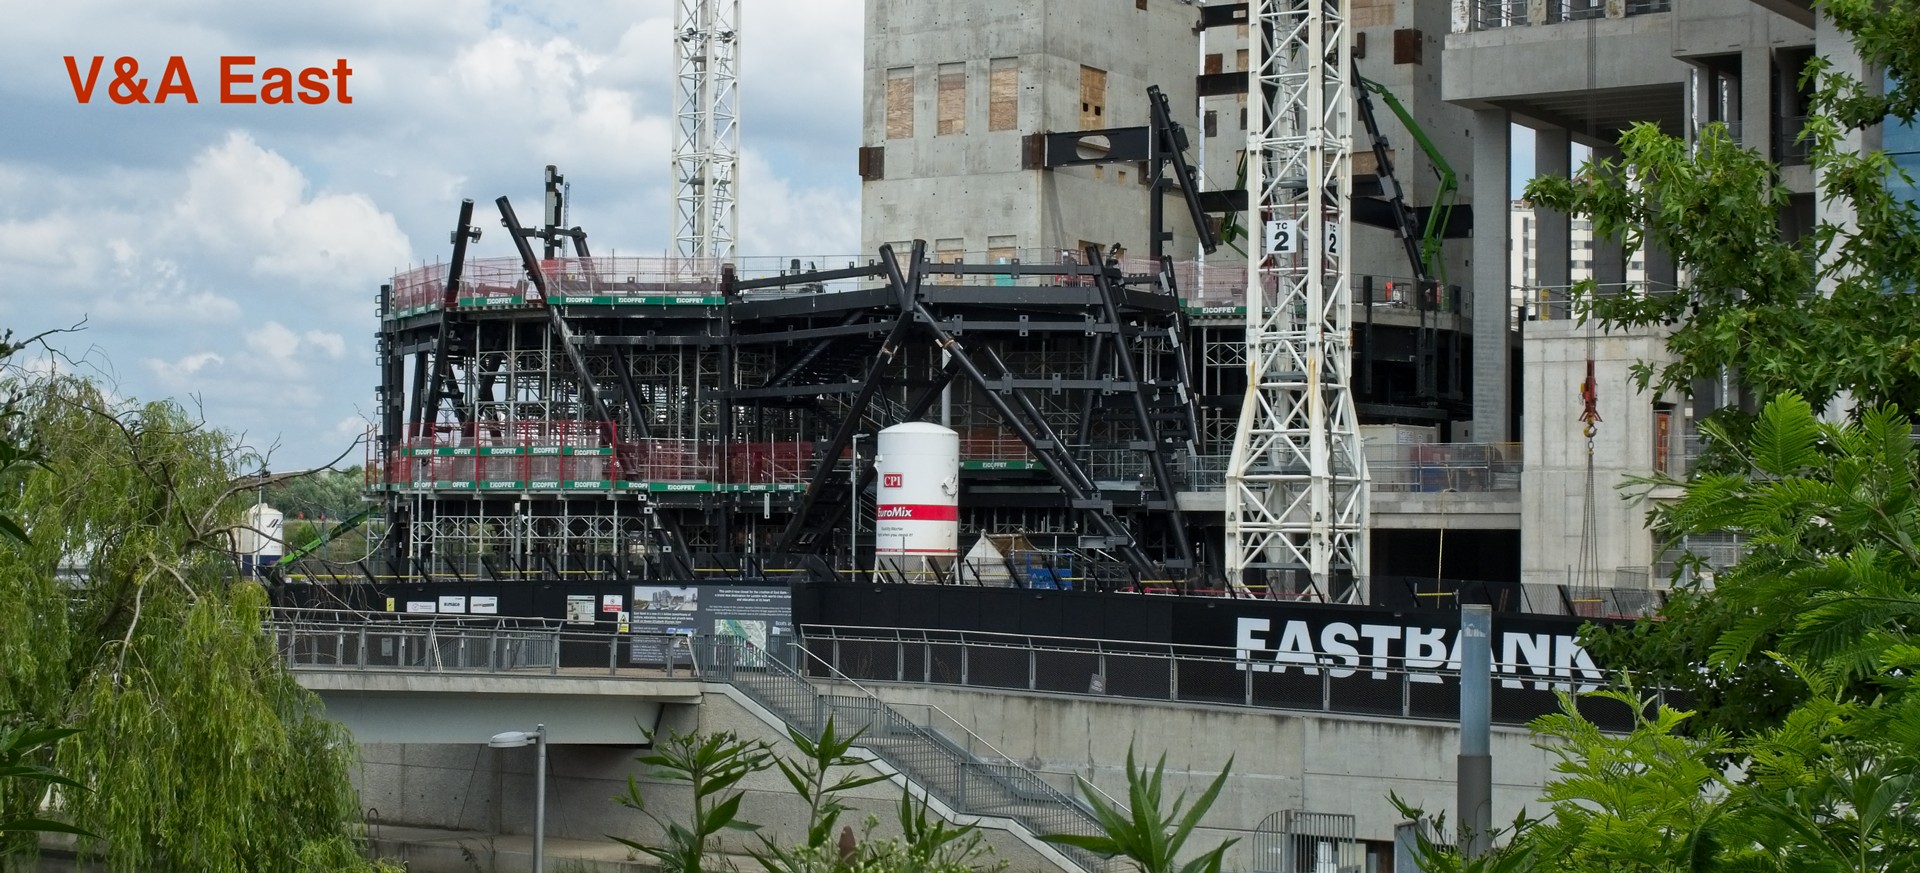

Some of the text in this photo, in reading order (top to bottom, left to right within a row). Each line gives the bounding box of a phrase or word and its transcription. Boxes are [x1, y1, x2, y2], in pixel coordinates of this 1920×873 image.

[1275, 222, 1288, 230] TC
[1329, 224, 1336, 232] TC
[1274, 231, 1289, 251] 2
[1328, 233, 1337, 254] 2
[884, 475, 901, 487] CPI
[877, 506, 913, 518] EuroMix
